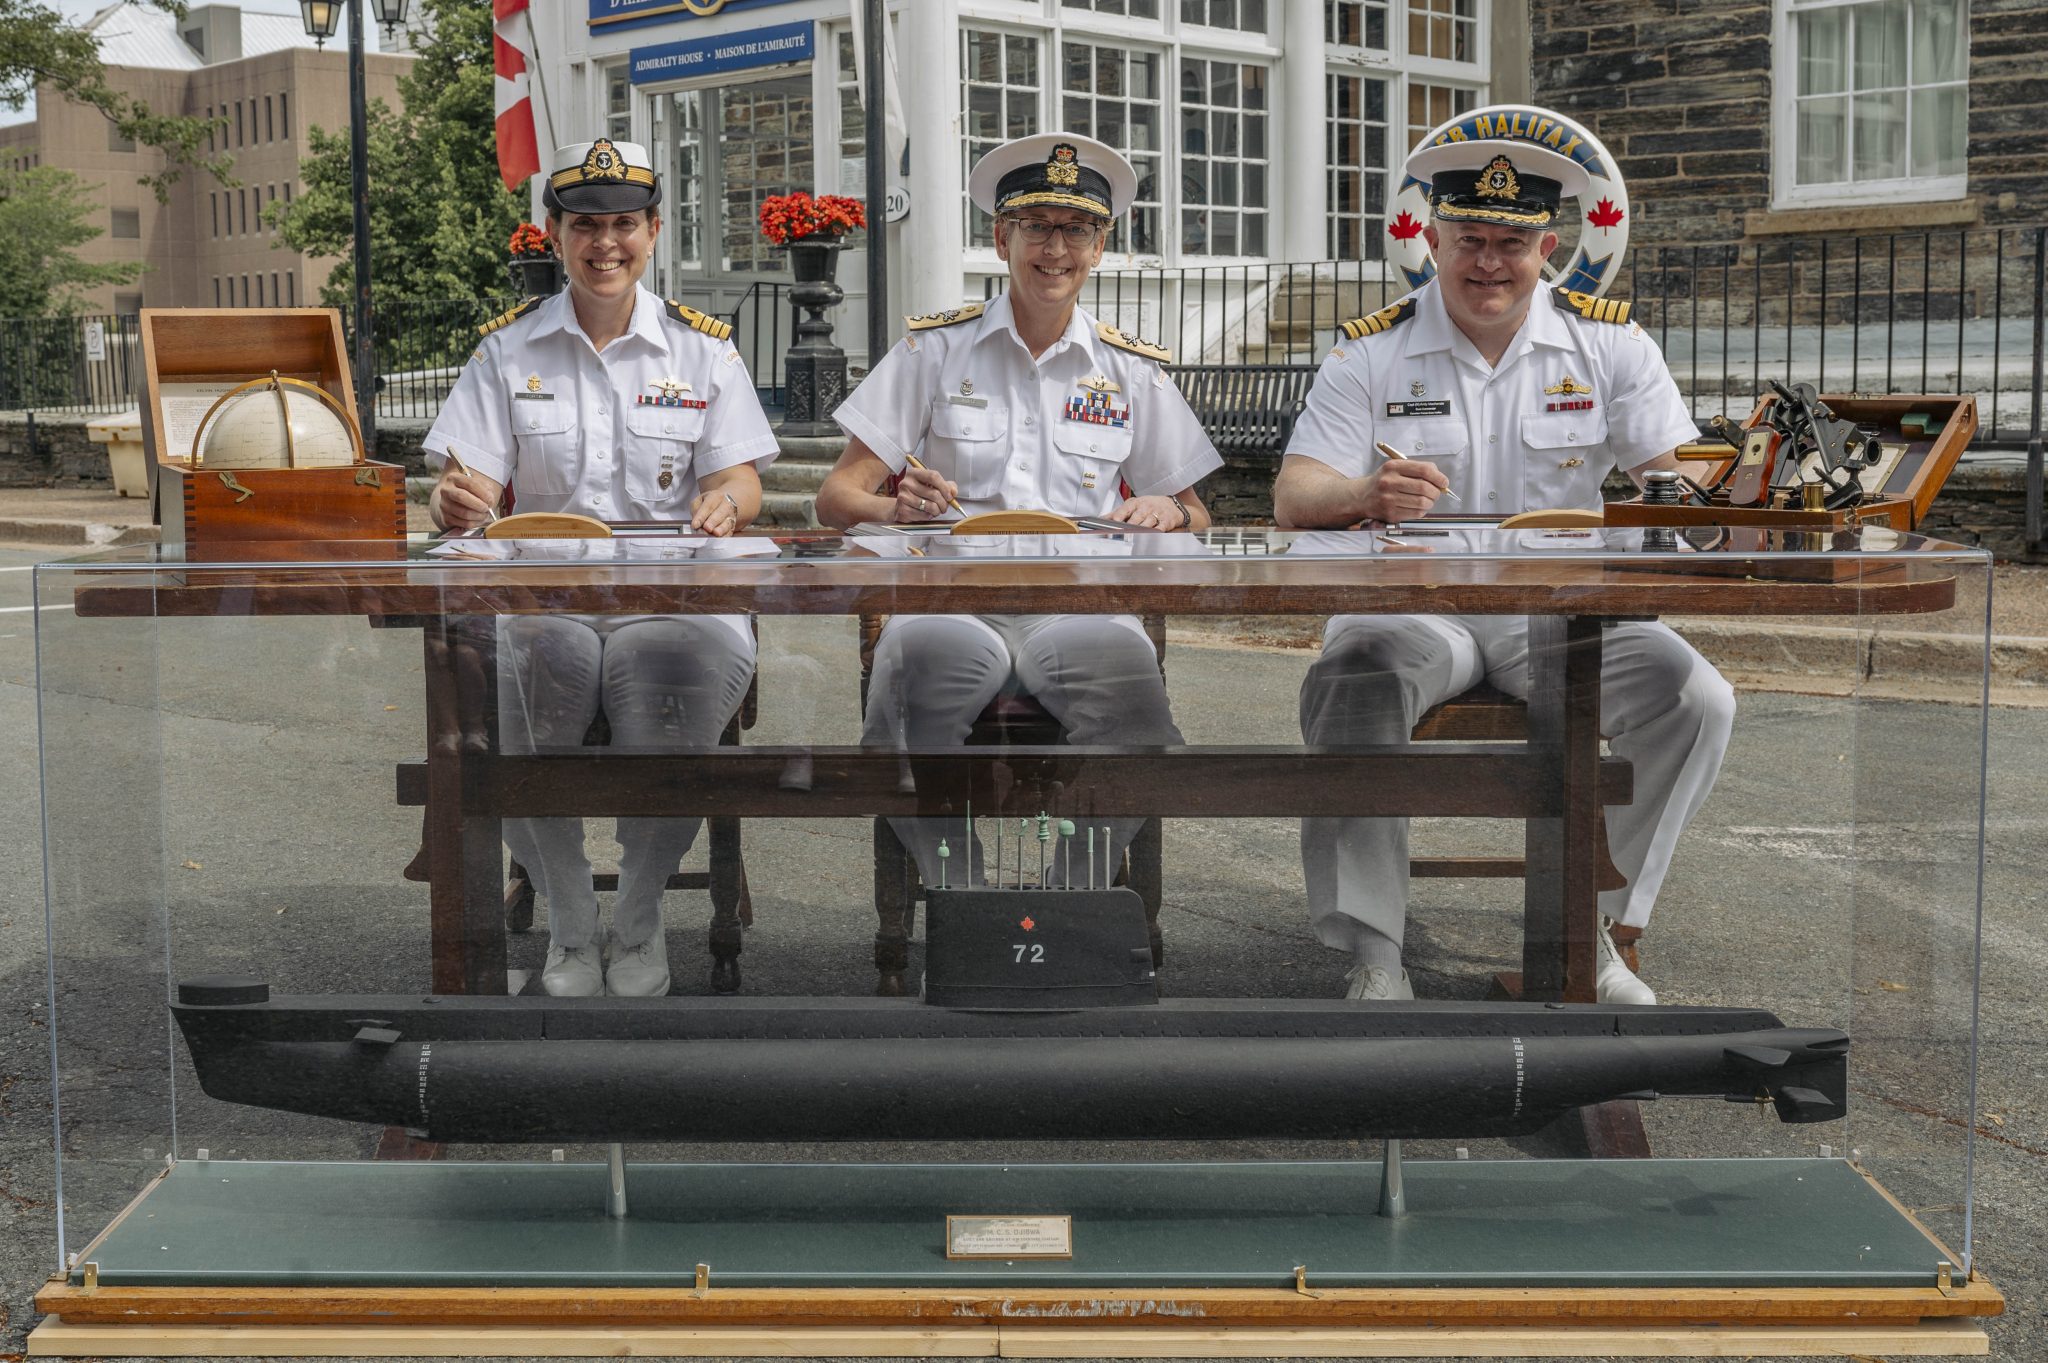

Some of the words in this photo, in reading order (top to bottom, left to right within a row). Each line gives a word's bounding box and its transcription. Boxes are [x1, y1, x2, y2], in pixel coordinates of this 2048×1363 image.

[635, 55, 678, 72] ADMIRALTY
[678, 51, 704, 66] HOUSE
[714, 45, 745, 60] MAISON
[745, 43, 758, 55] DE
[757, 33, 806, 53] L'AMIRAUTÉ
[1475, 113, 1583, 157] HALIFAX
[1012, 944, 1045, 963] 72
